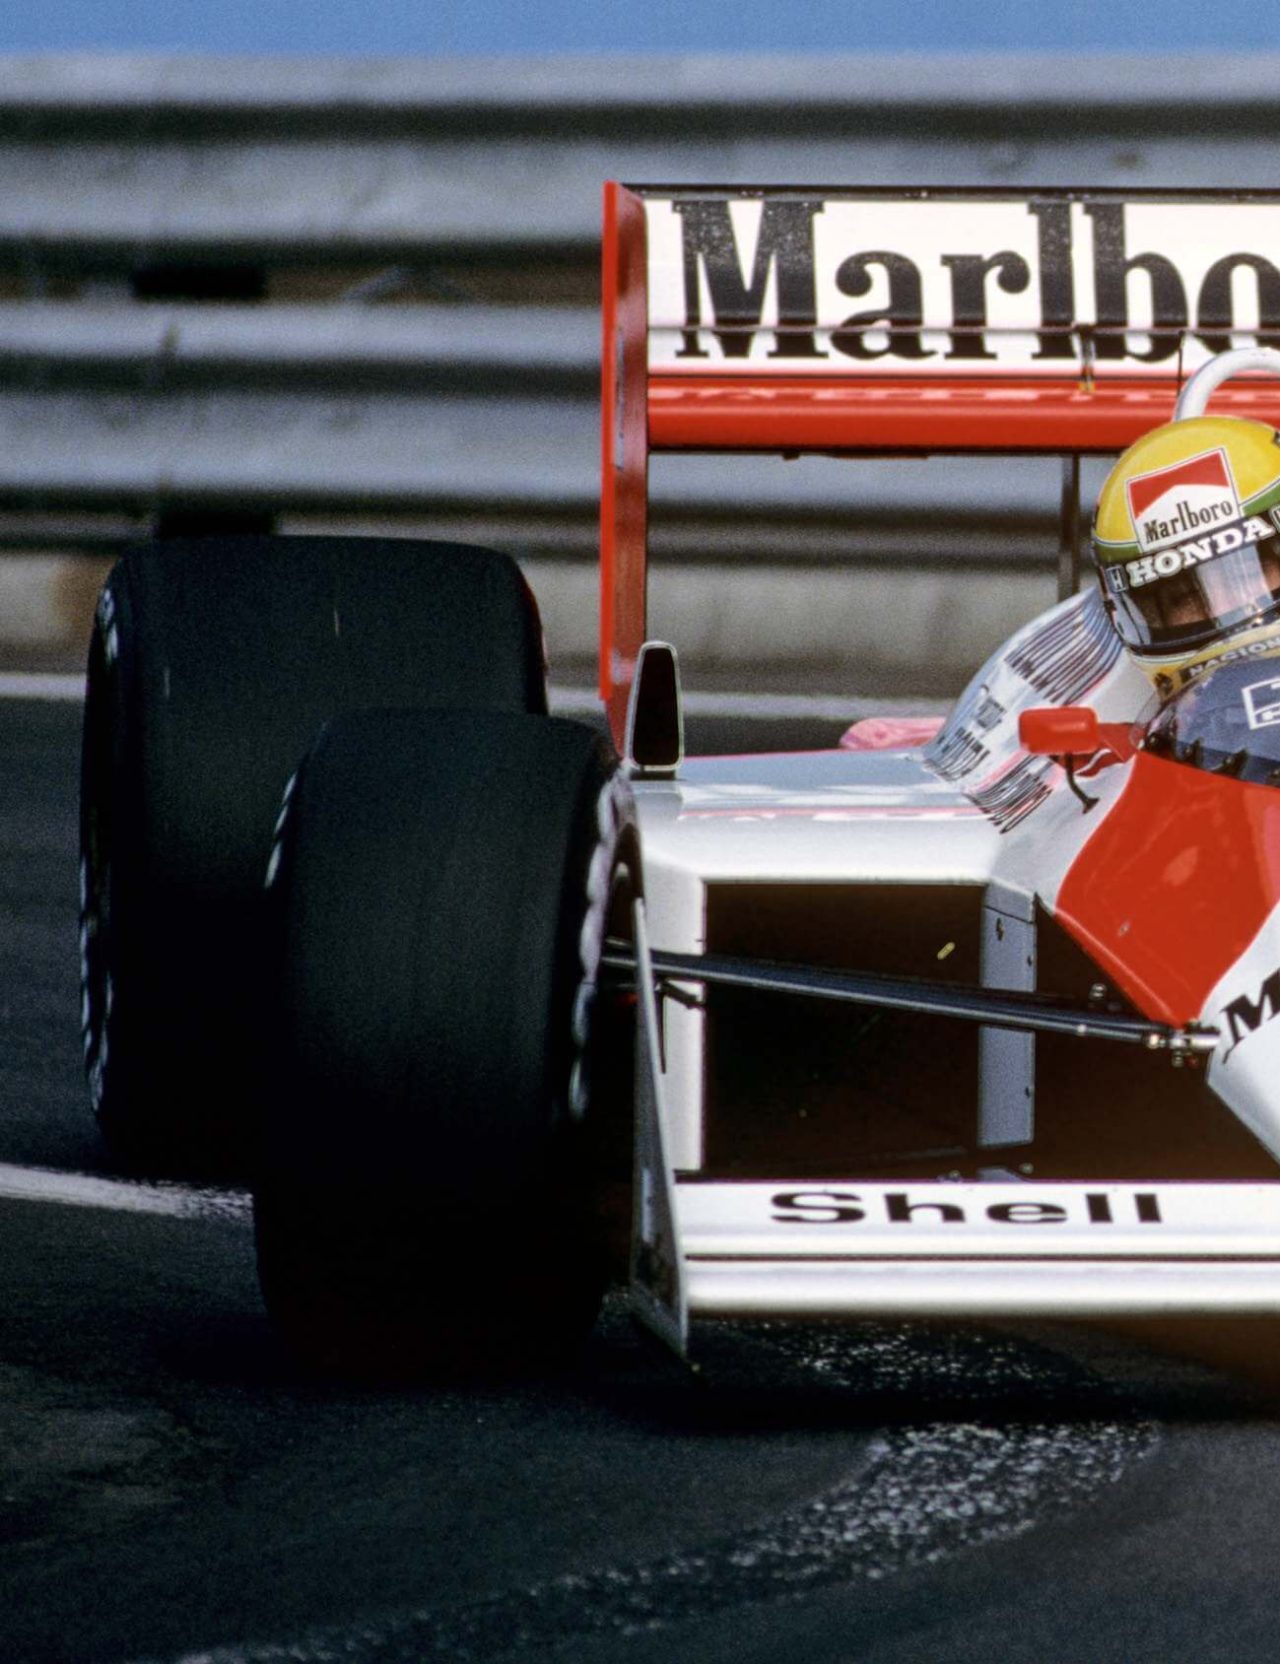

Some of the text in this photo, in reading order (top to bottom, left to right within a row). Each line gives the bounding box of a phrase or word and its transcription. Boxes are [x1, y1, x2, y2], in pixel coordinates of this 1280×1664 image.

[1143, 499, 1234, 545] Marlboro
[1125, 517, 1275, 587] HONDA
[769, 1191, 1163, 1224] Shell
